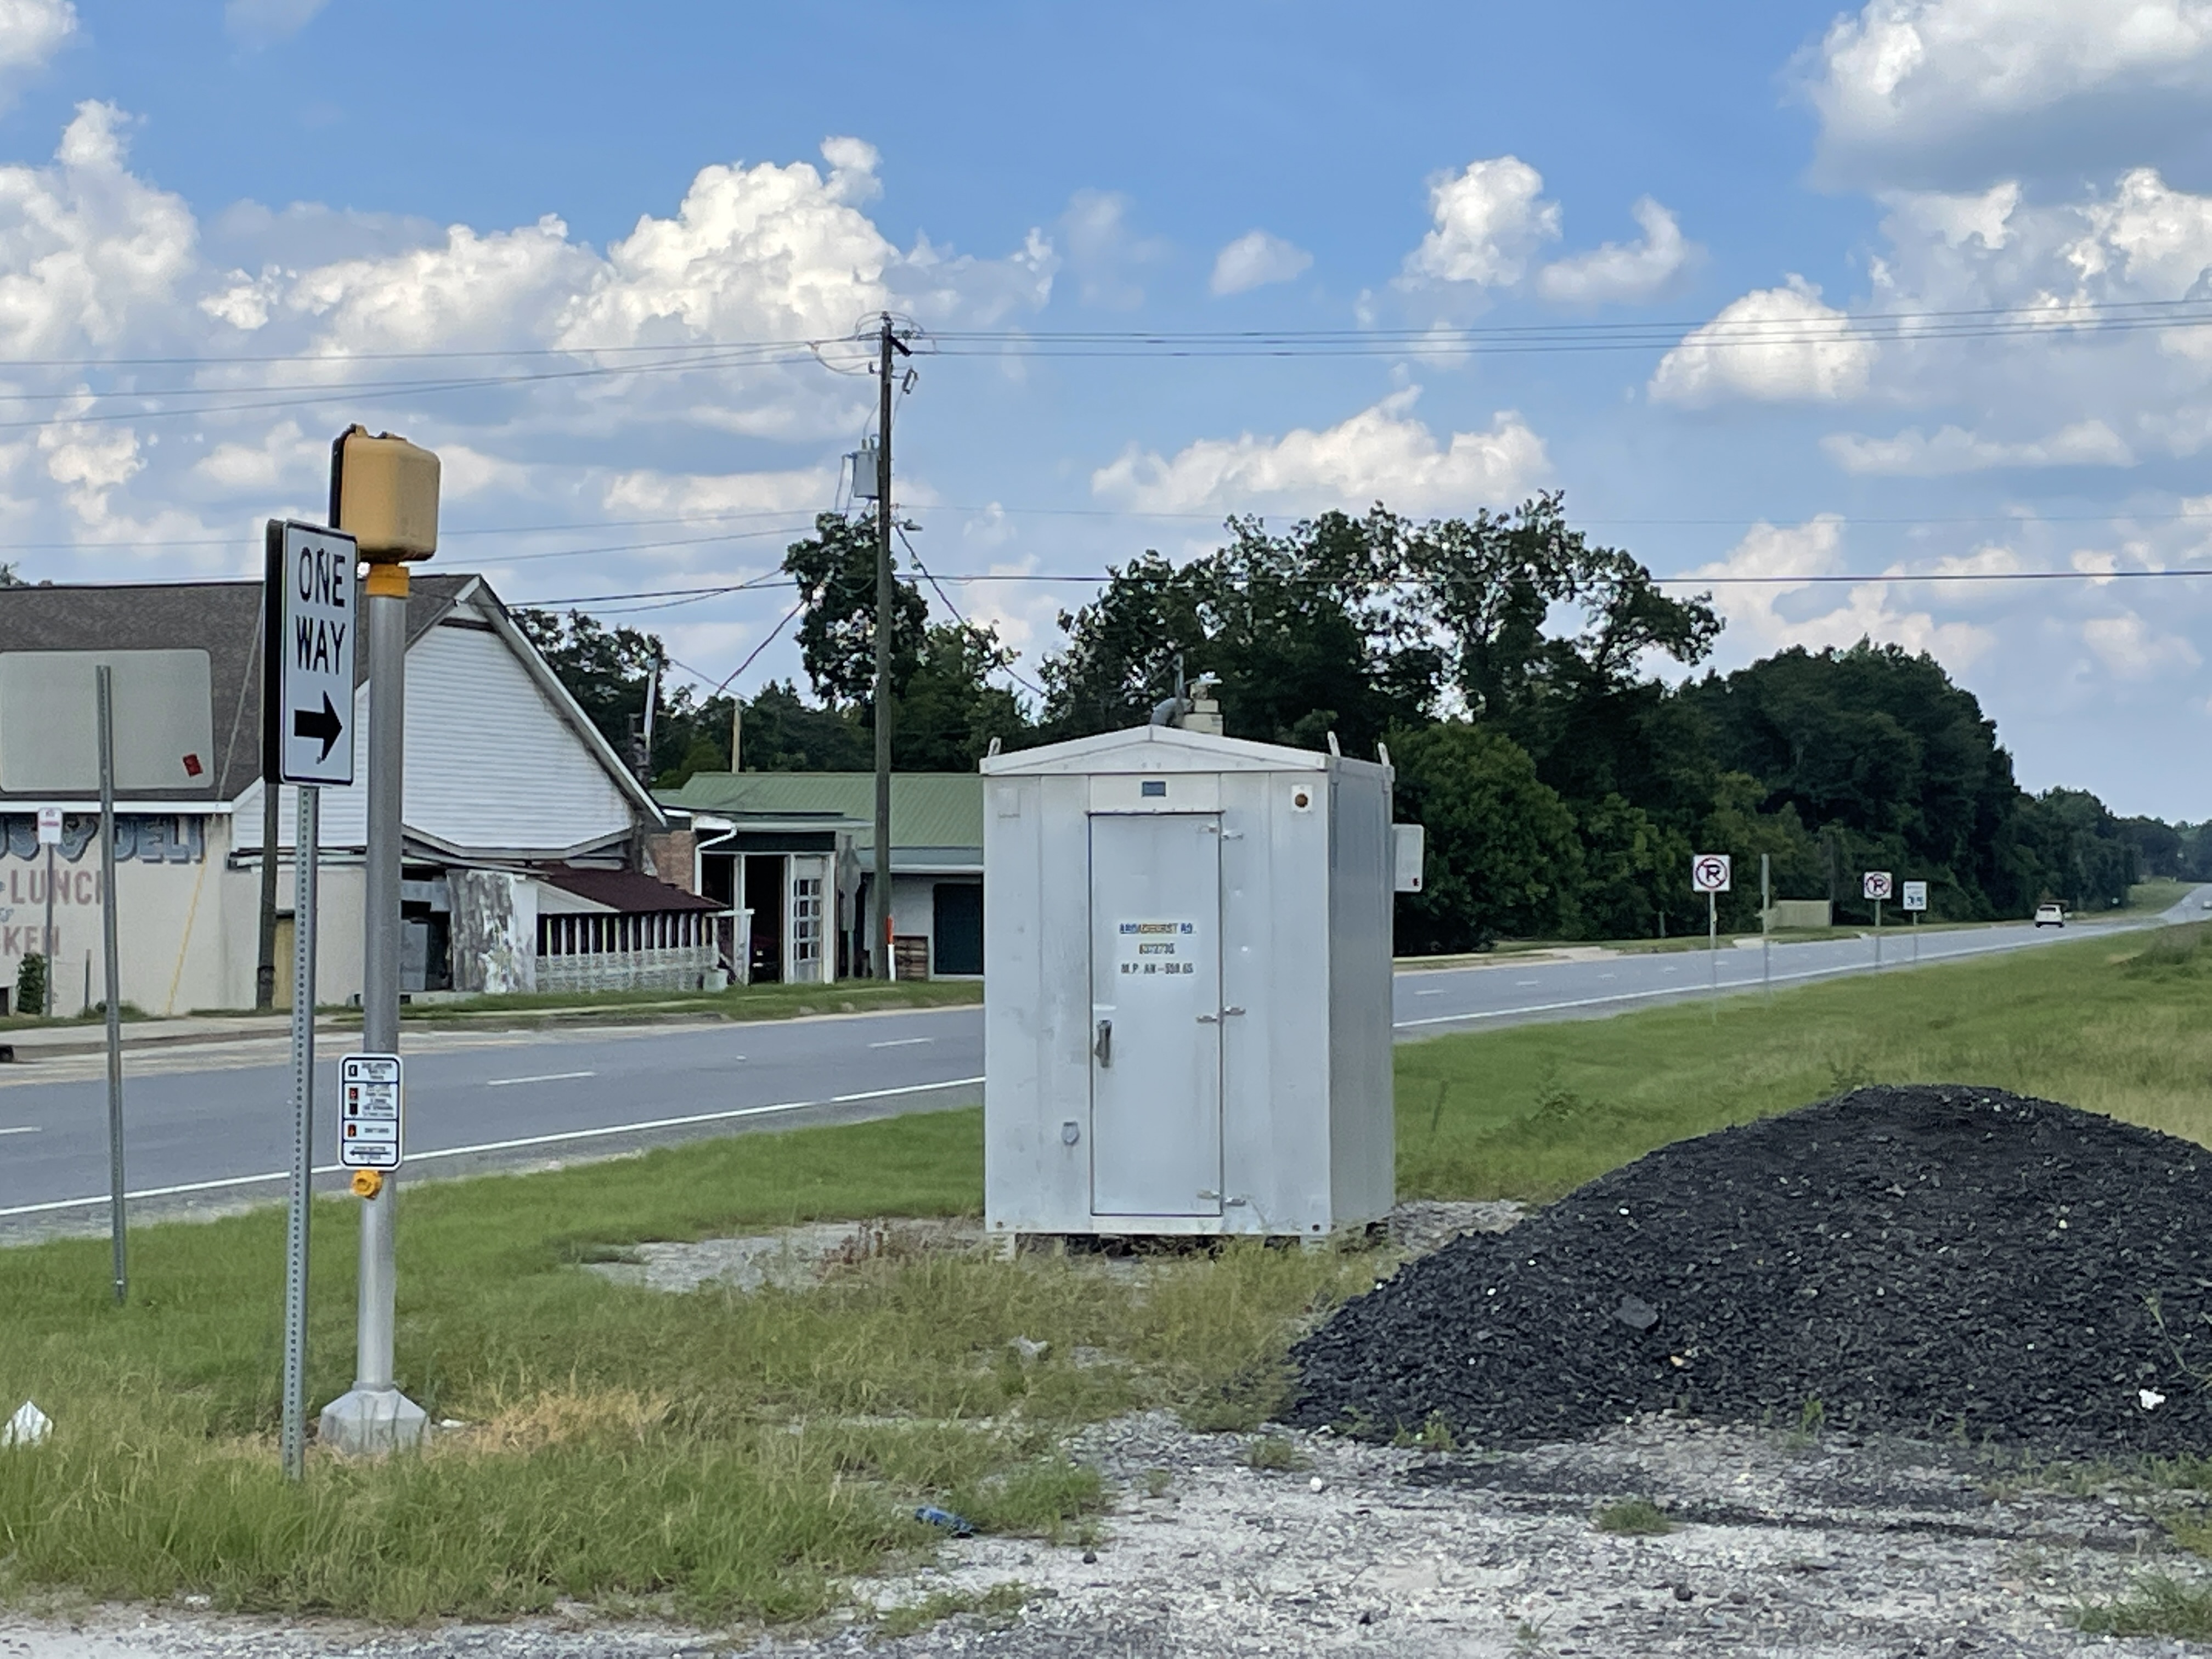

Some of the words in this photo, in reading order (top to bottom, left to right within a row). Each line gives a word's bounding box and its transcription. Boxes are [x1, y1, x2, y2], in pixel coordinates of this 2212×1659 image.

[299, 547, 345, 607] ONE
[296, 615, 346, 675] WAY
[113, 813, 205, 864] DELI
